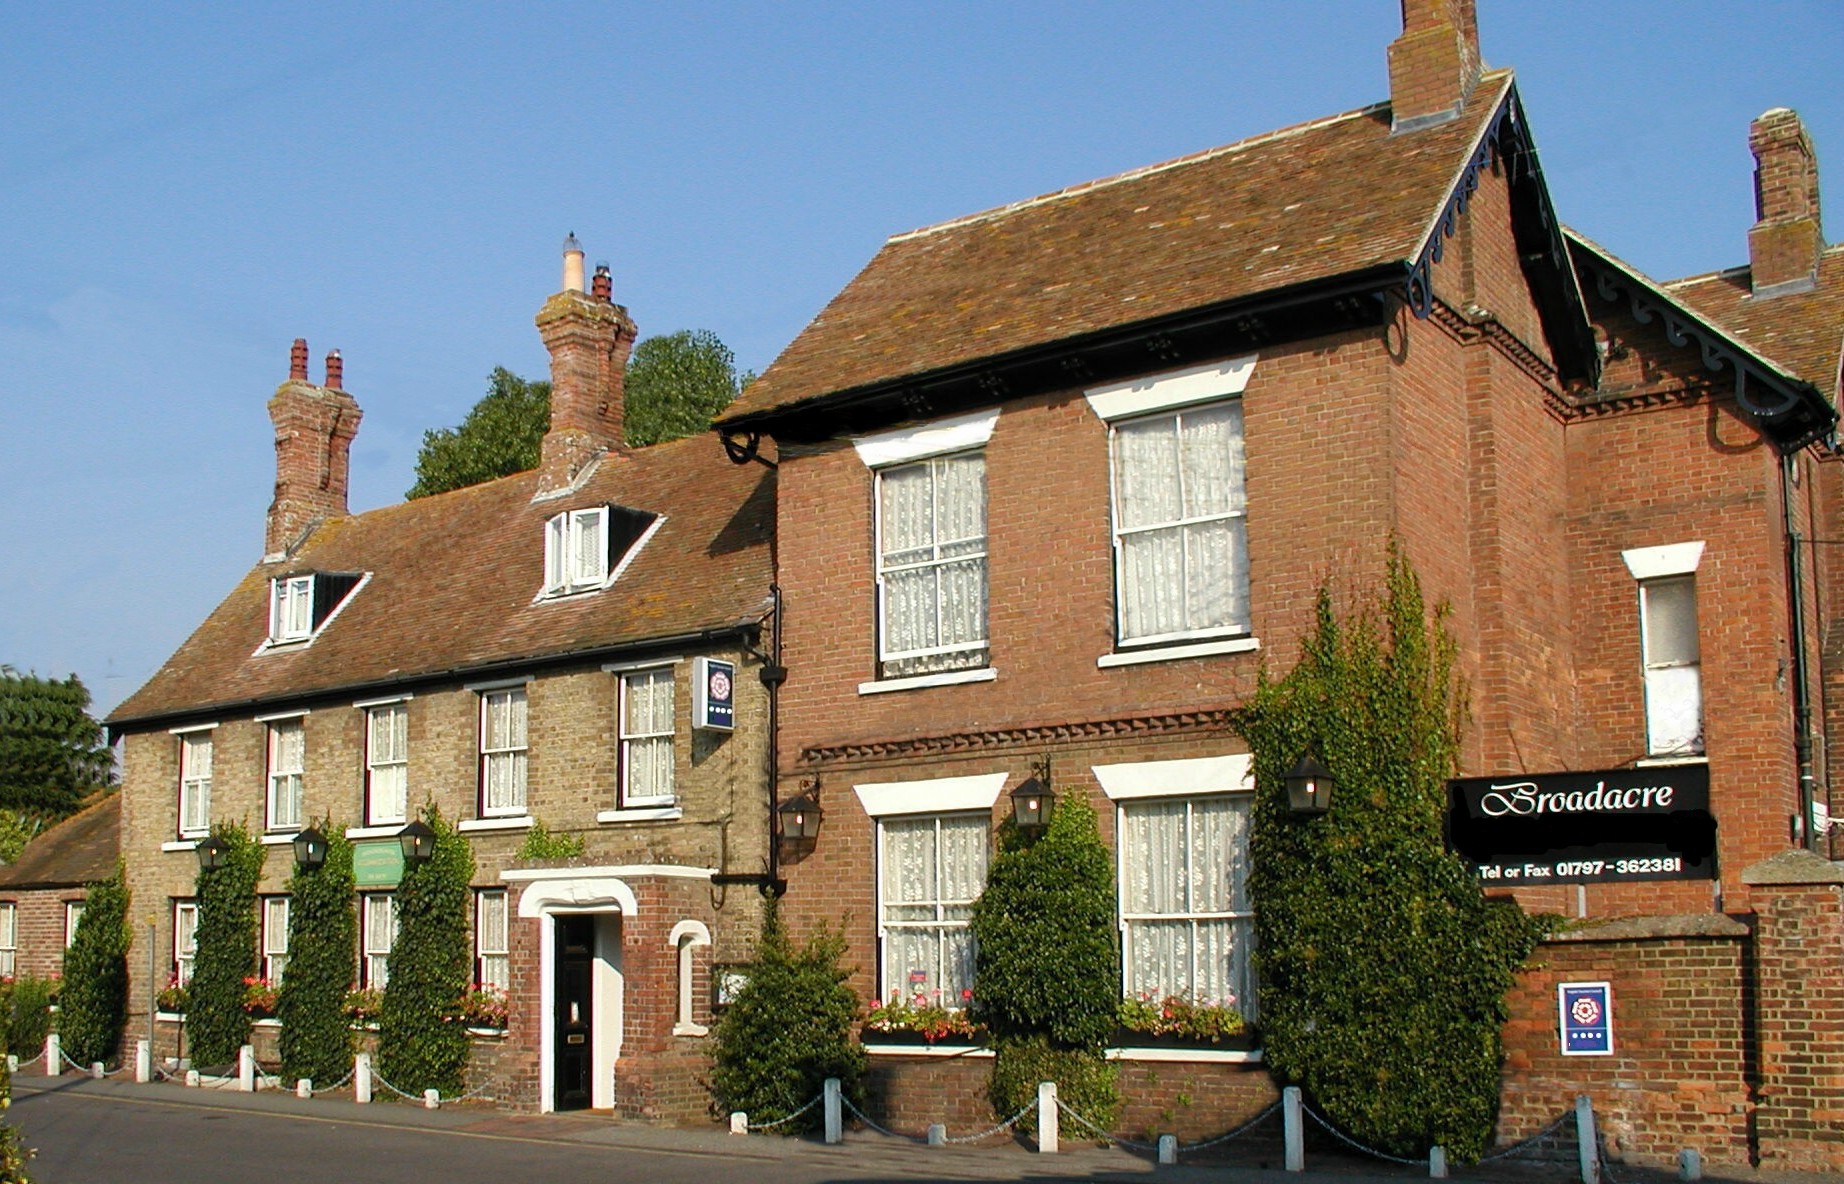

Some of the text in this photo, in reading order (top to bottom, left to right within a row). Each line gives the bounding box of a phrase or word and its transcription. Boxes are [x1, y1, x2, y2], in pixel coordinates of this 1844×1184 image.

[1481, 781, 1674, 816] Broadacre
[1479, 865, 1501, 880] Tel
[1504, 867, 1520, 879] or
[1524, 863, 1551, 878] Fax
